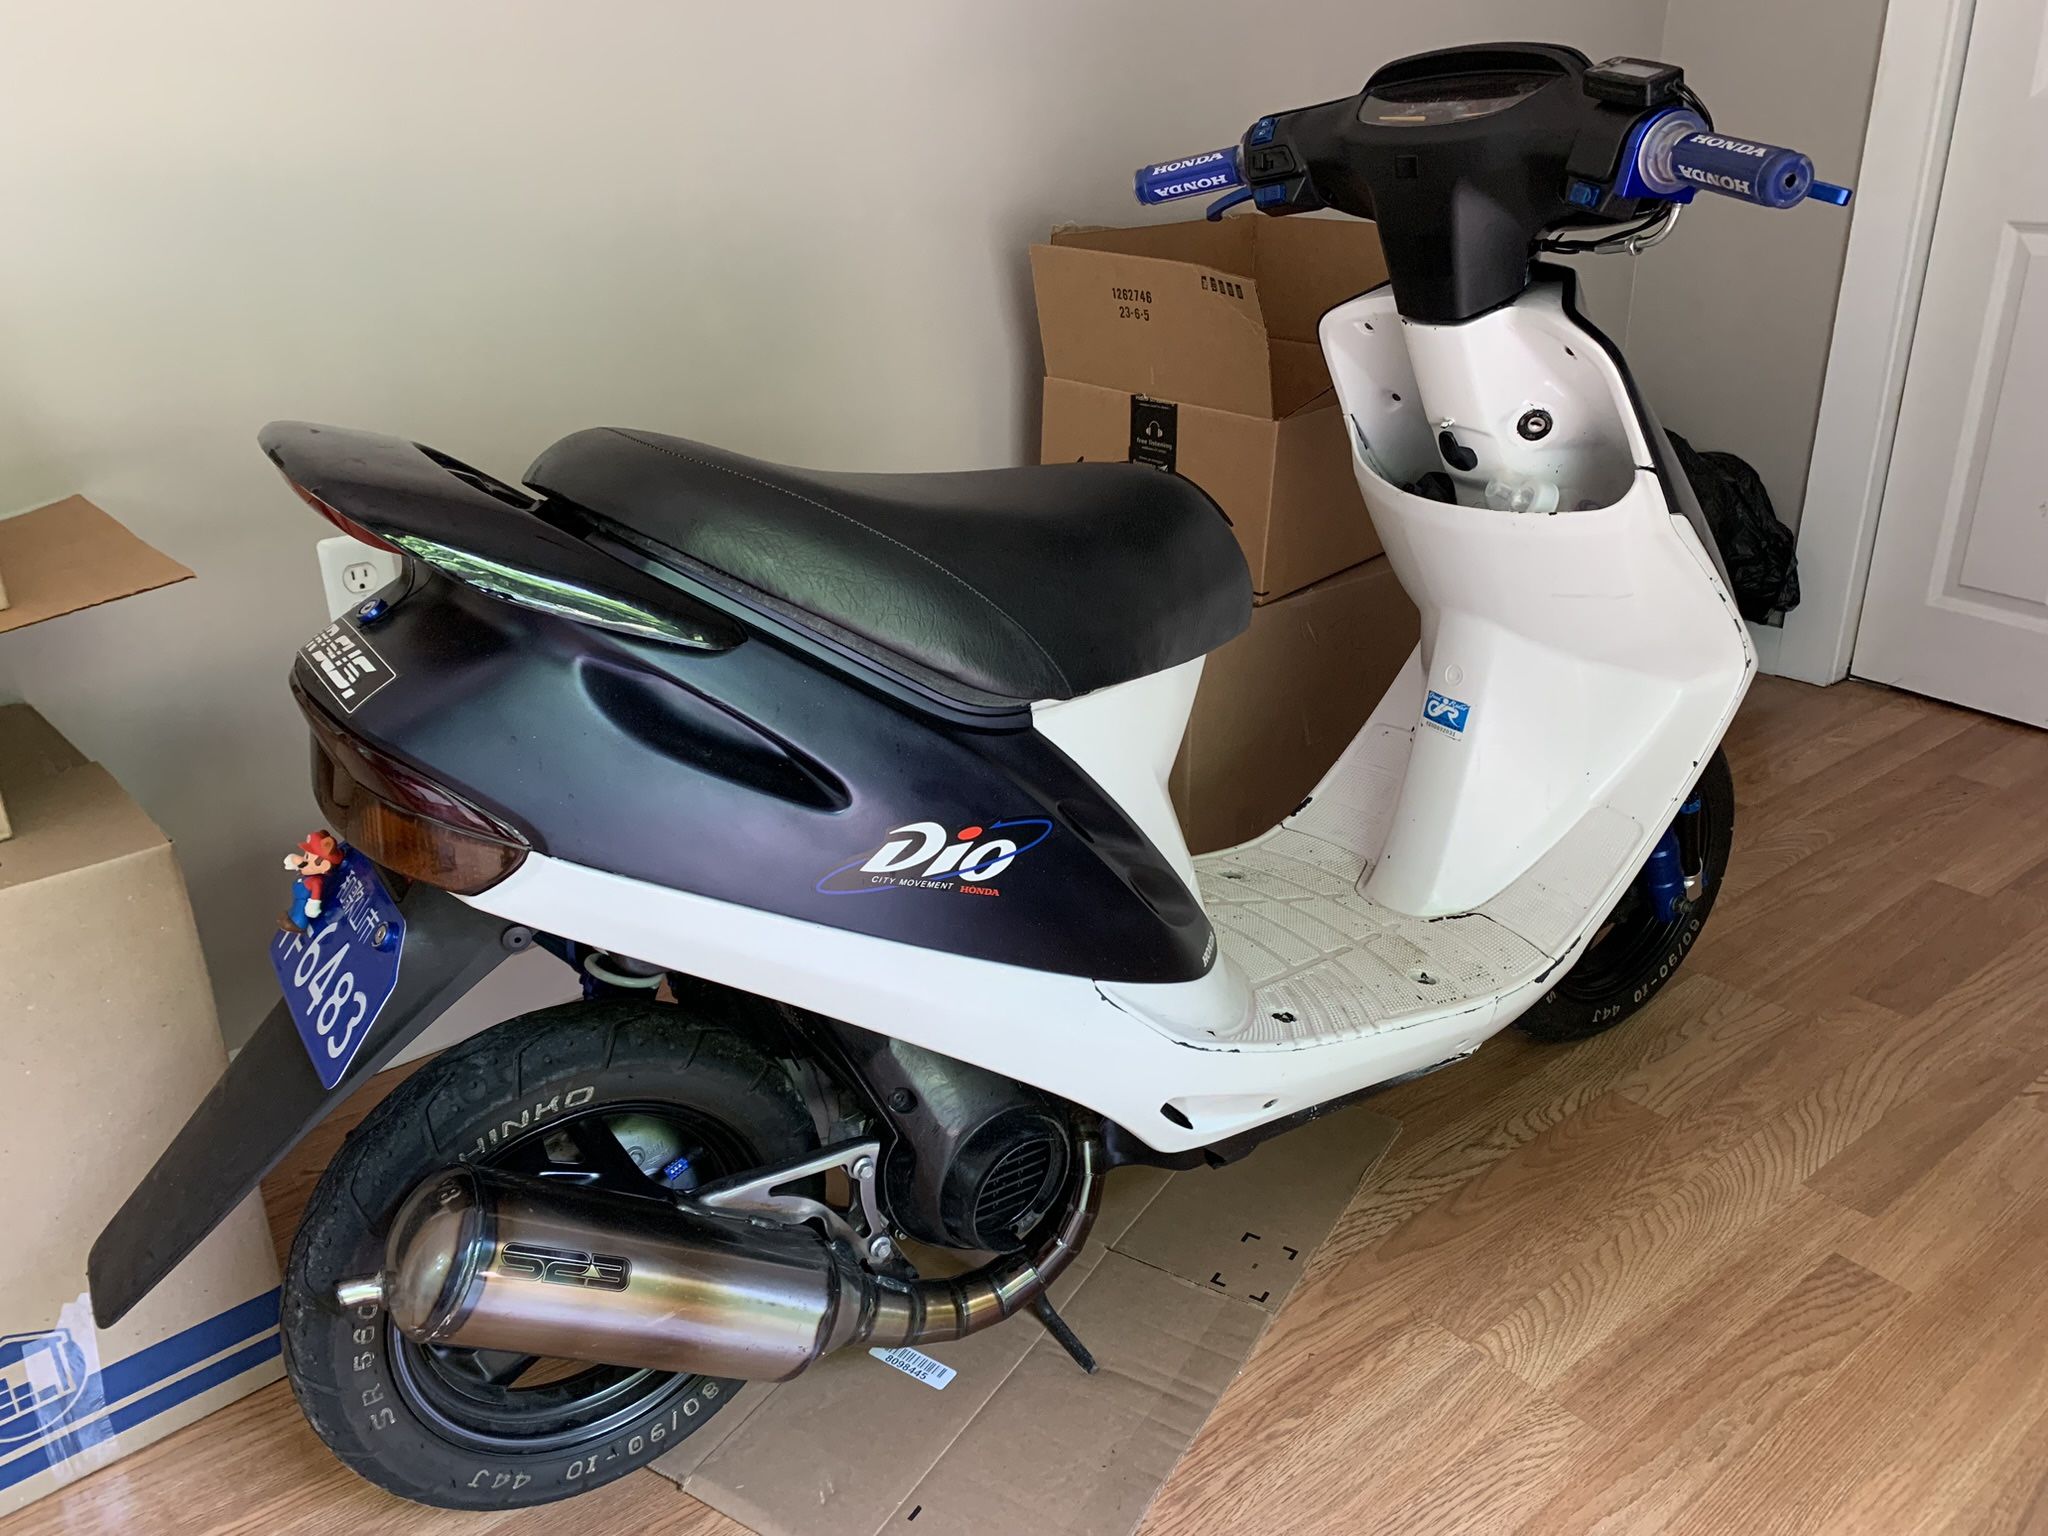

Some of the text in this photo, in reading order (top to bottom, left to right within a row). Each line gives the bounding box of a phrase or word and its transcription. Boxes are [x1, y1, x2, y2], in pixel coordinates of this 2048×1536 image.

[1691, 134, 1768, 158] HONDA
[1152, 152, 1224, 176] HONDA
[1154, 174, 1229, 198] HONDA
[1678, 164, 1751, 195] HONDA
[1111, 287, 1153, 304] 1262746
[860, 821, 1017, 882] Dio
[871, 875, 1001, 897] CITY MOVEMENT HONDA
[335, 868, 380, 946] 和歌山市
[458, 1086, 595, 1163] HINKO
[884, 1354, 929, 1381] 8098445
[565, 1381, 720, 1481] 80/90-10
